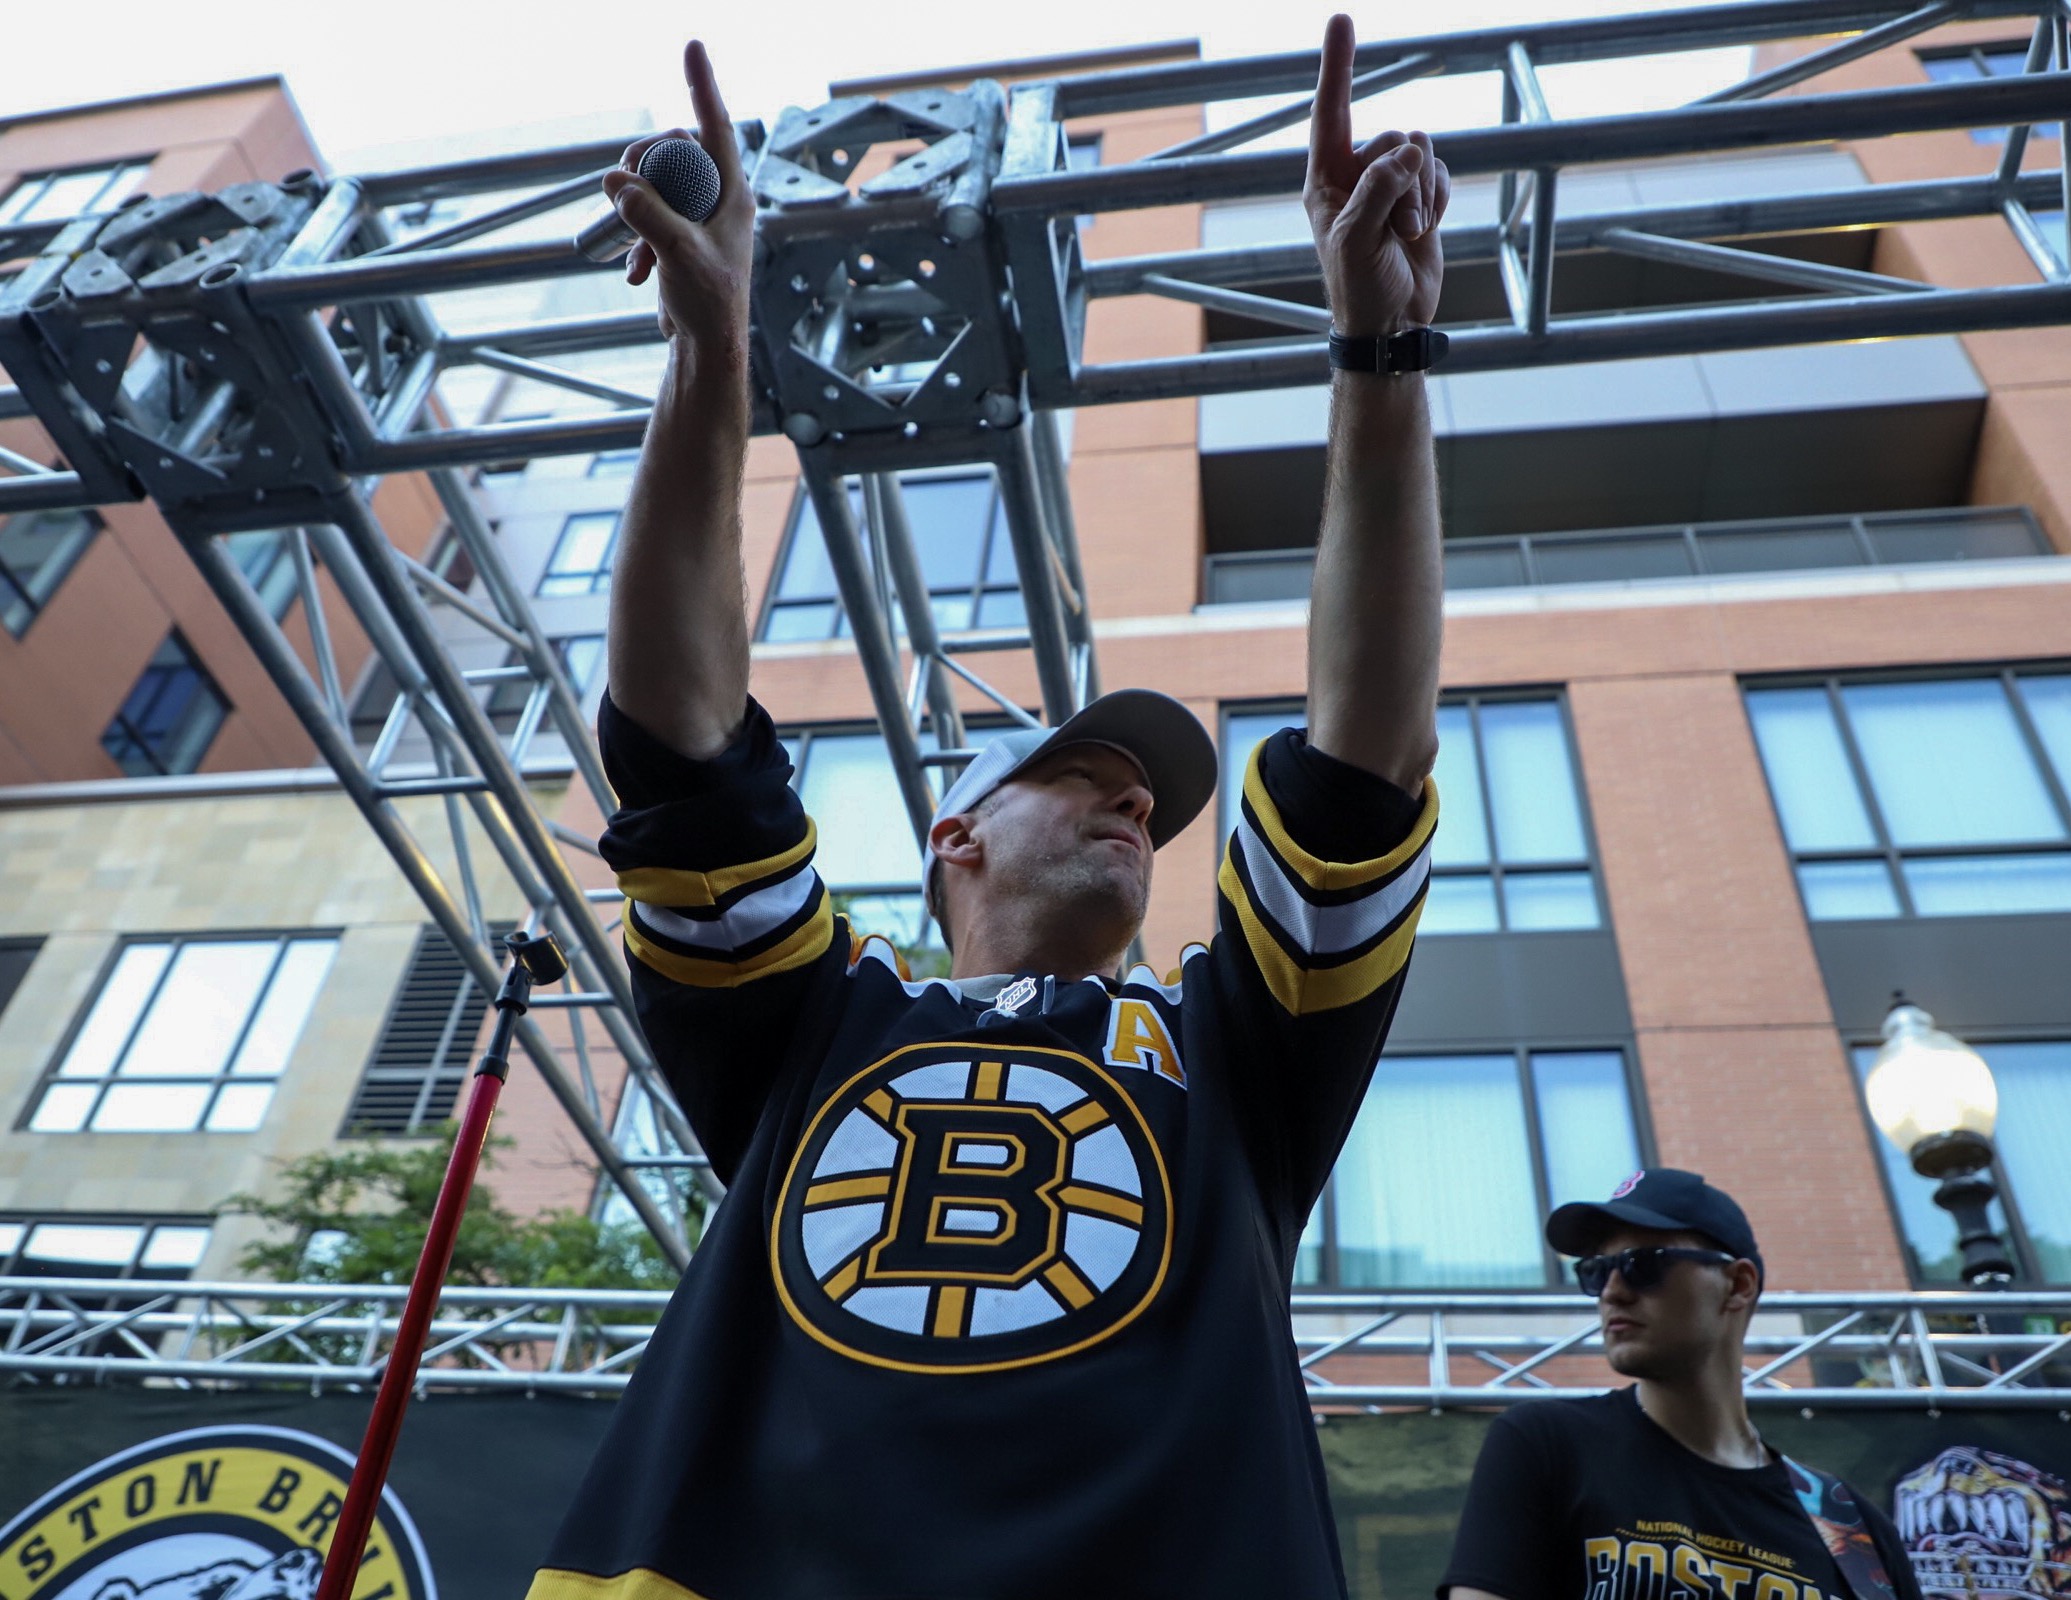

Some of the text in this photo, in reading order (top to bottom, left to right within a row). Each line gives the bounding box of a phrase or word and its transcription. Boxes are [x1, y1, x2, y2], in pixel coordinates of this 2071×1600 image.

[1102, 998, 1187, 1091] A
[865, 1104, 1068, 1283] B
[0, 1459, 222, 1600] STON
[1636, 1520, 1793, 1569] NATIONAL HOCKEY LEAGUE
